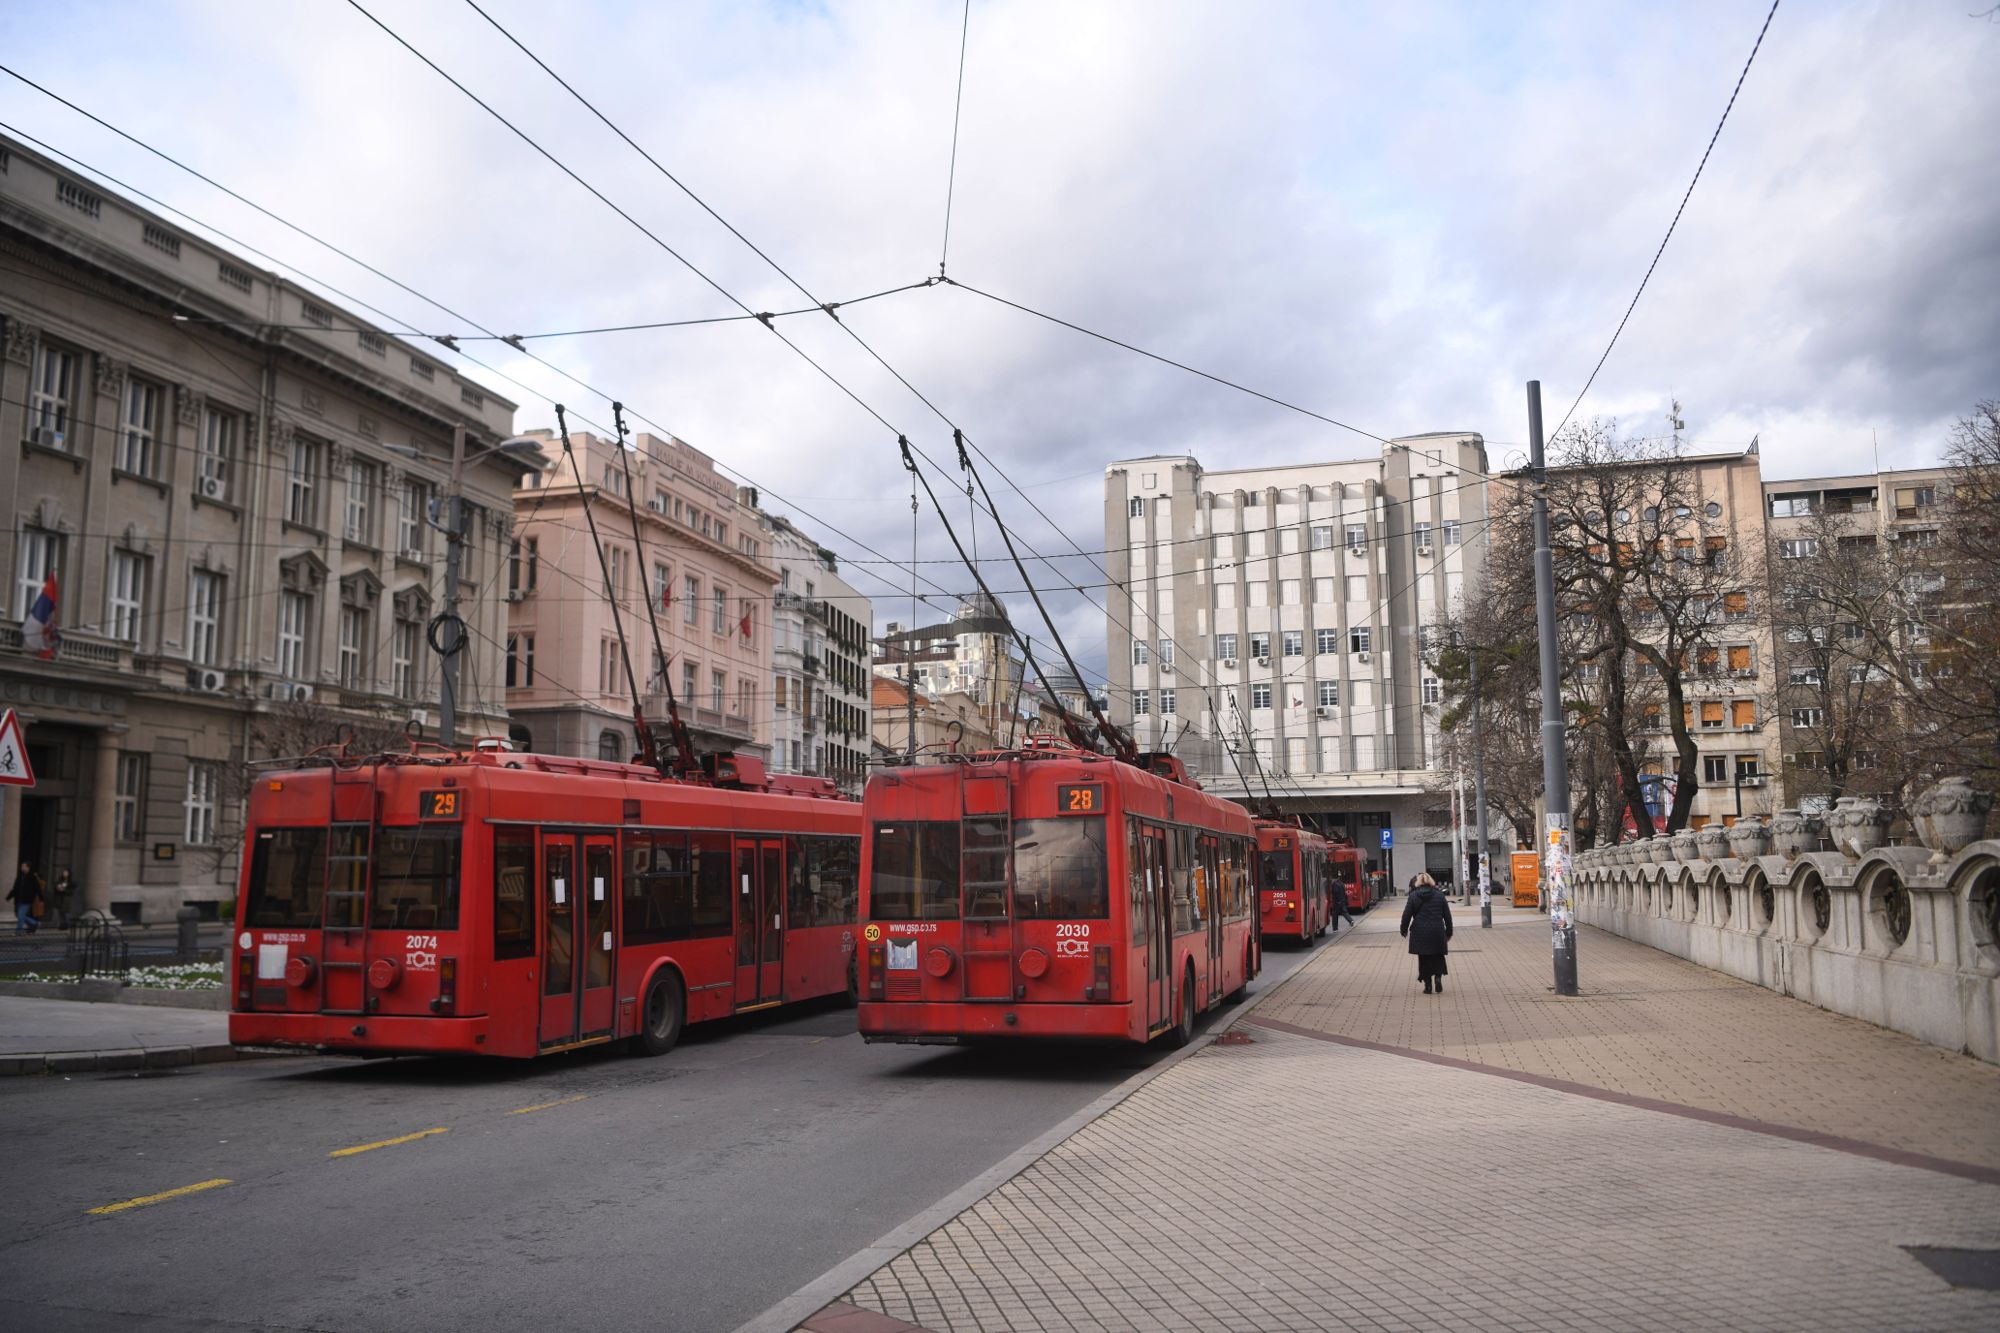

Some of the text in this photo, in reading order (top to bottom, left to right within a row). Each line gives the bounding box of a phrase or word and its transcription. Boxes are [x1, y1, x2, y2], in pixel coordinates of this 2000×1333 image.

[434, 793, 455, 815] 29
[1070, 790, 1091, 810] 28
[1383, 831, 1390, 841] P
[866, 928, 879, 938] 50
[889, 923, 937, 934] www.gsp.co.rs
[1056, 924, 1089, 937] 2030
[406, 935, 437, 949] 2074
